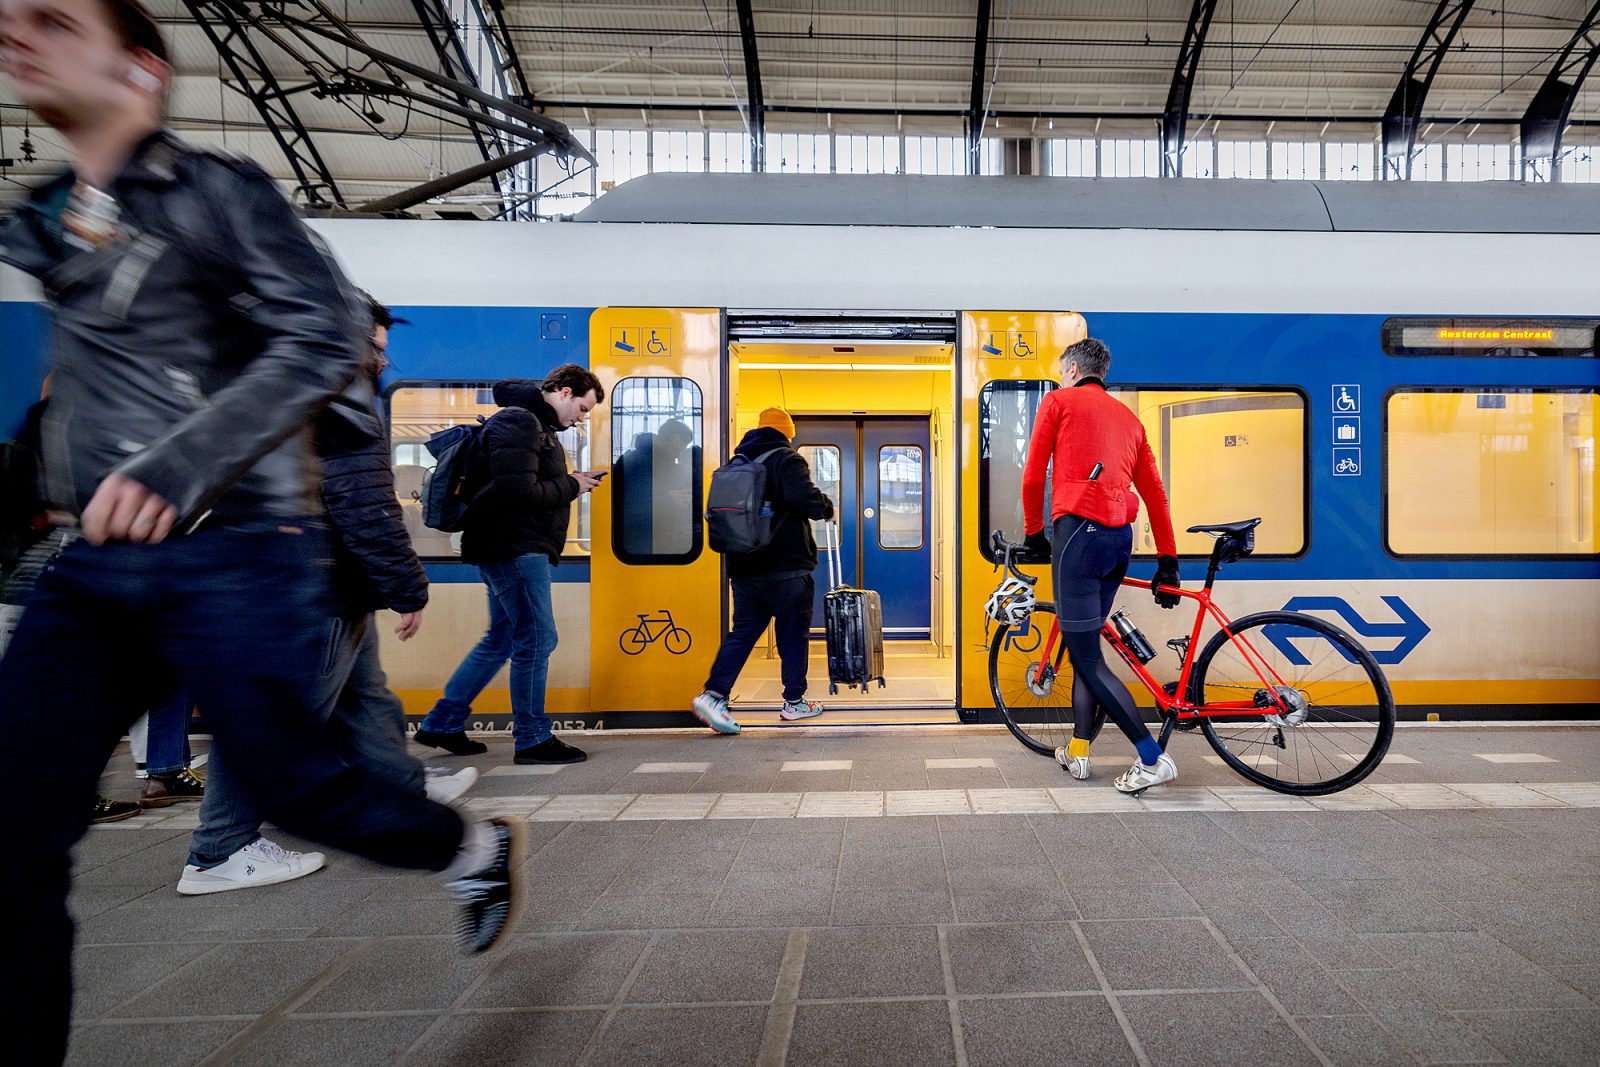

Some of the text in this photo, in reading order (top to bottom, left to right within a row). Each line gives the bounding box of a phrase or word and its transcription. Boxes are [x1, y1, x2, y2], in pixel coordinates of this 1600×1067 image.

[1440, 329, 1552, 339] Amsterdam Centraal
[473, 721, 494, 732] 84
